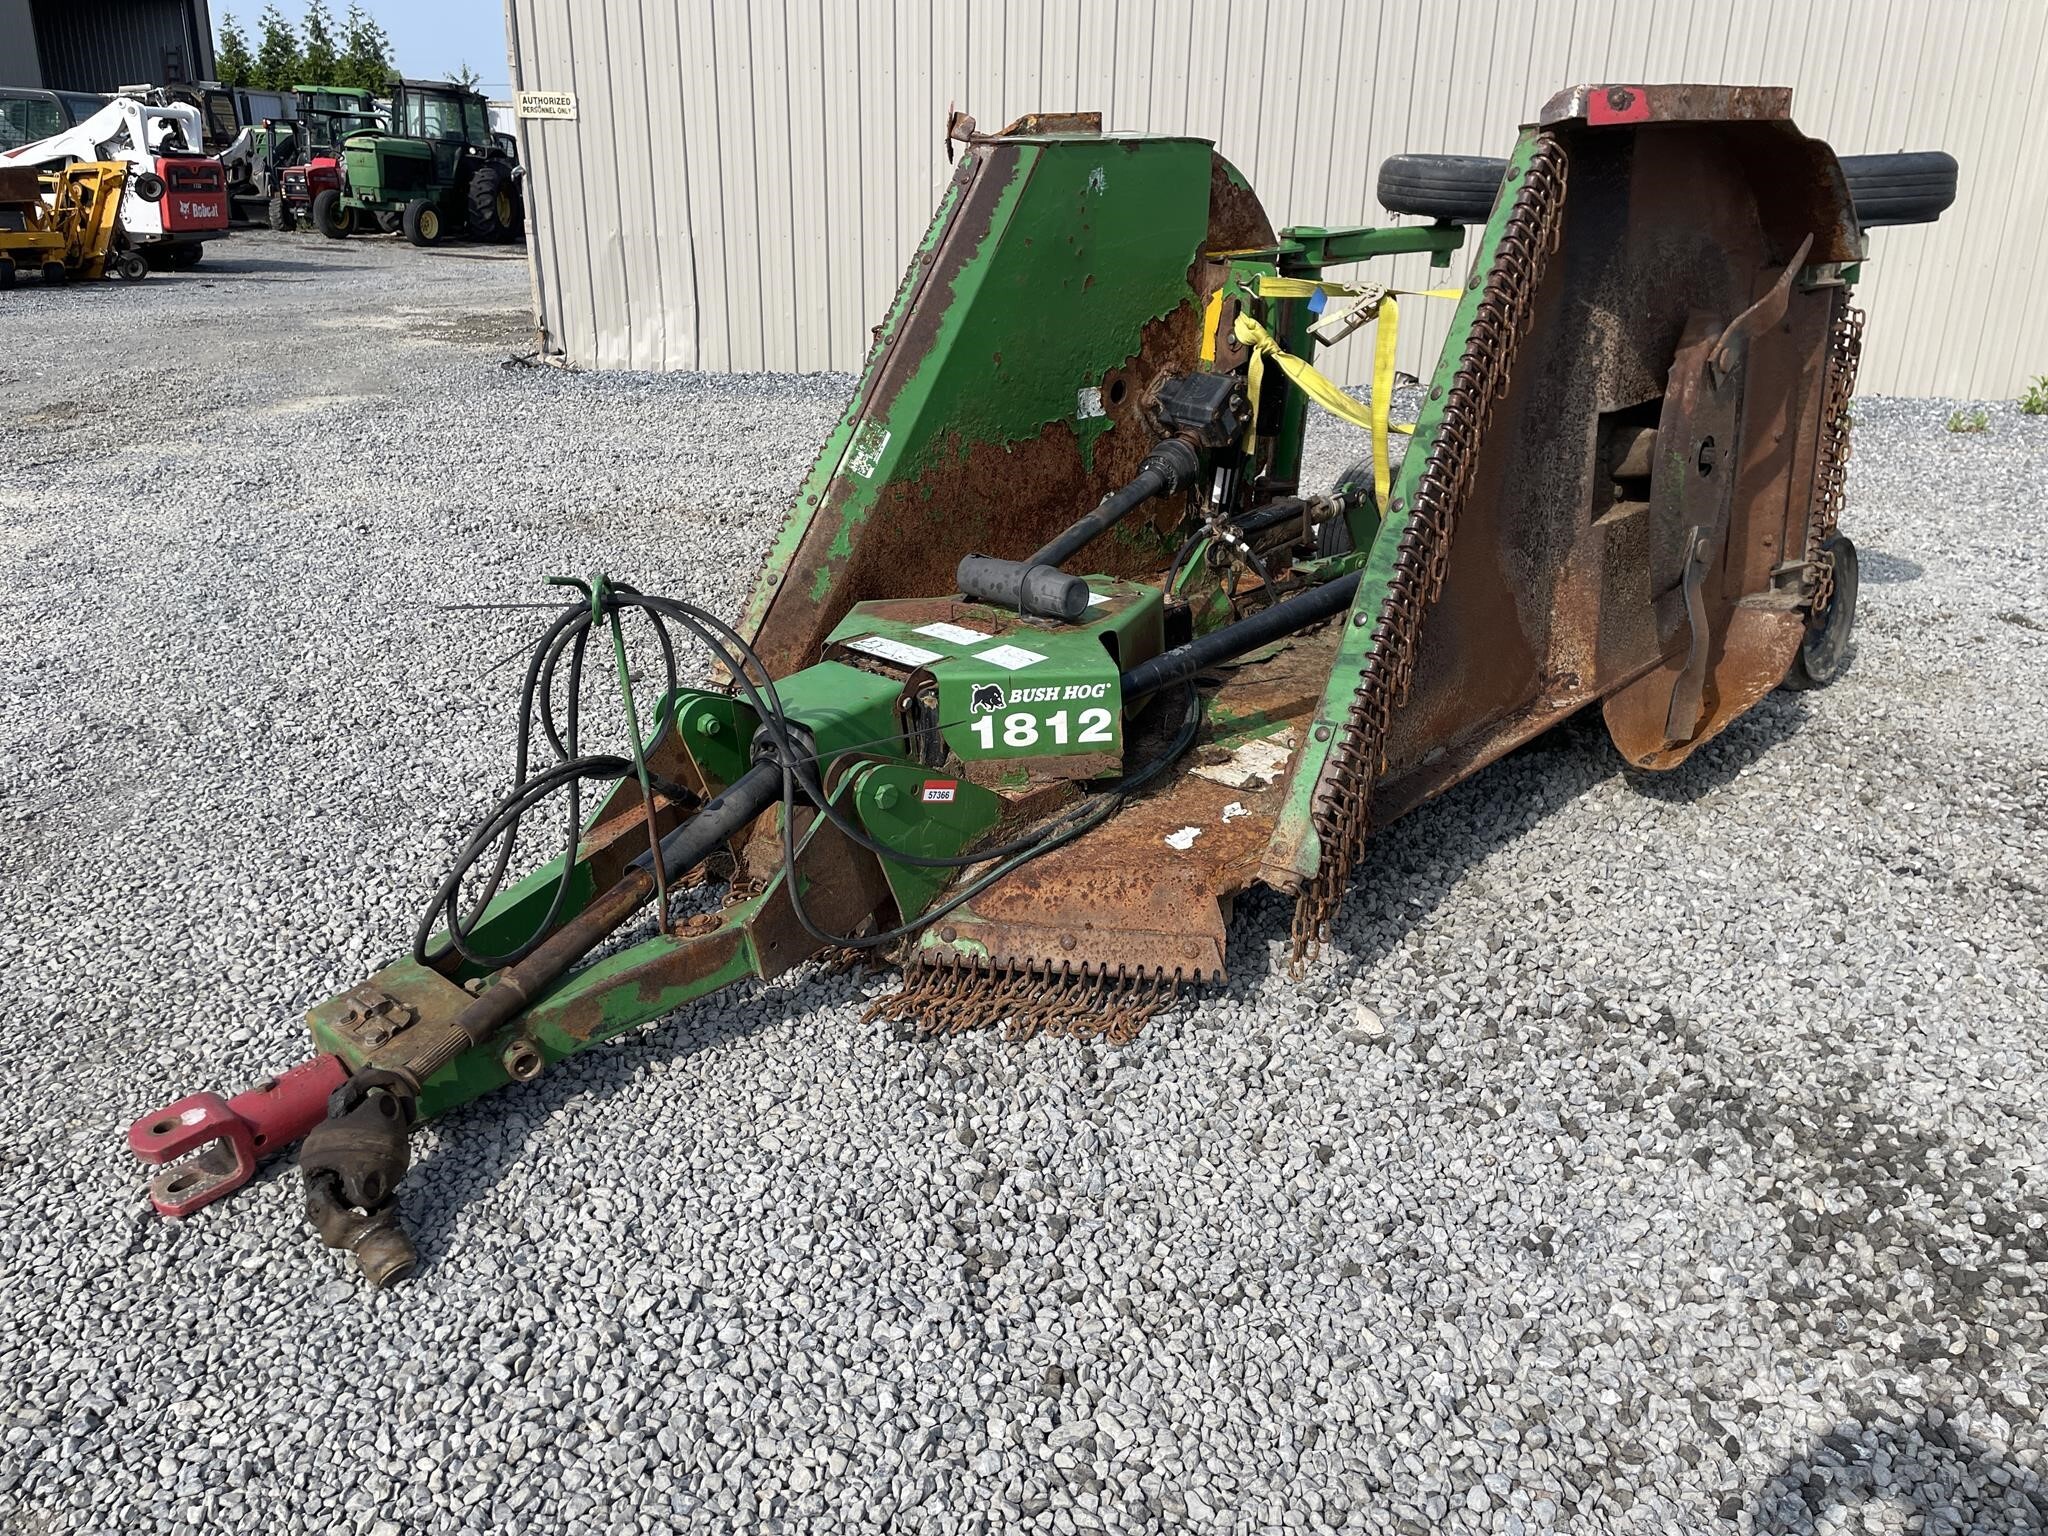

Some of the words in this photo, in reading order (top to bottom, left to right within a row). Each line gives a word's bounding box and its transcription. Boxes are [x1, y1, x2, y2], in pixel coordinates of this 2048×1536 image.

[522, 96, 571, 105] AUTHORIZED
[522, 106, 556, 114] PERSONNEL
[192, 203, 218, 218] Bobcat
[1008, 687, 1061, 704] BUSH
[970, 707, 1113, 750] 1812
[928, 791, 950, 800] 57366
